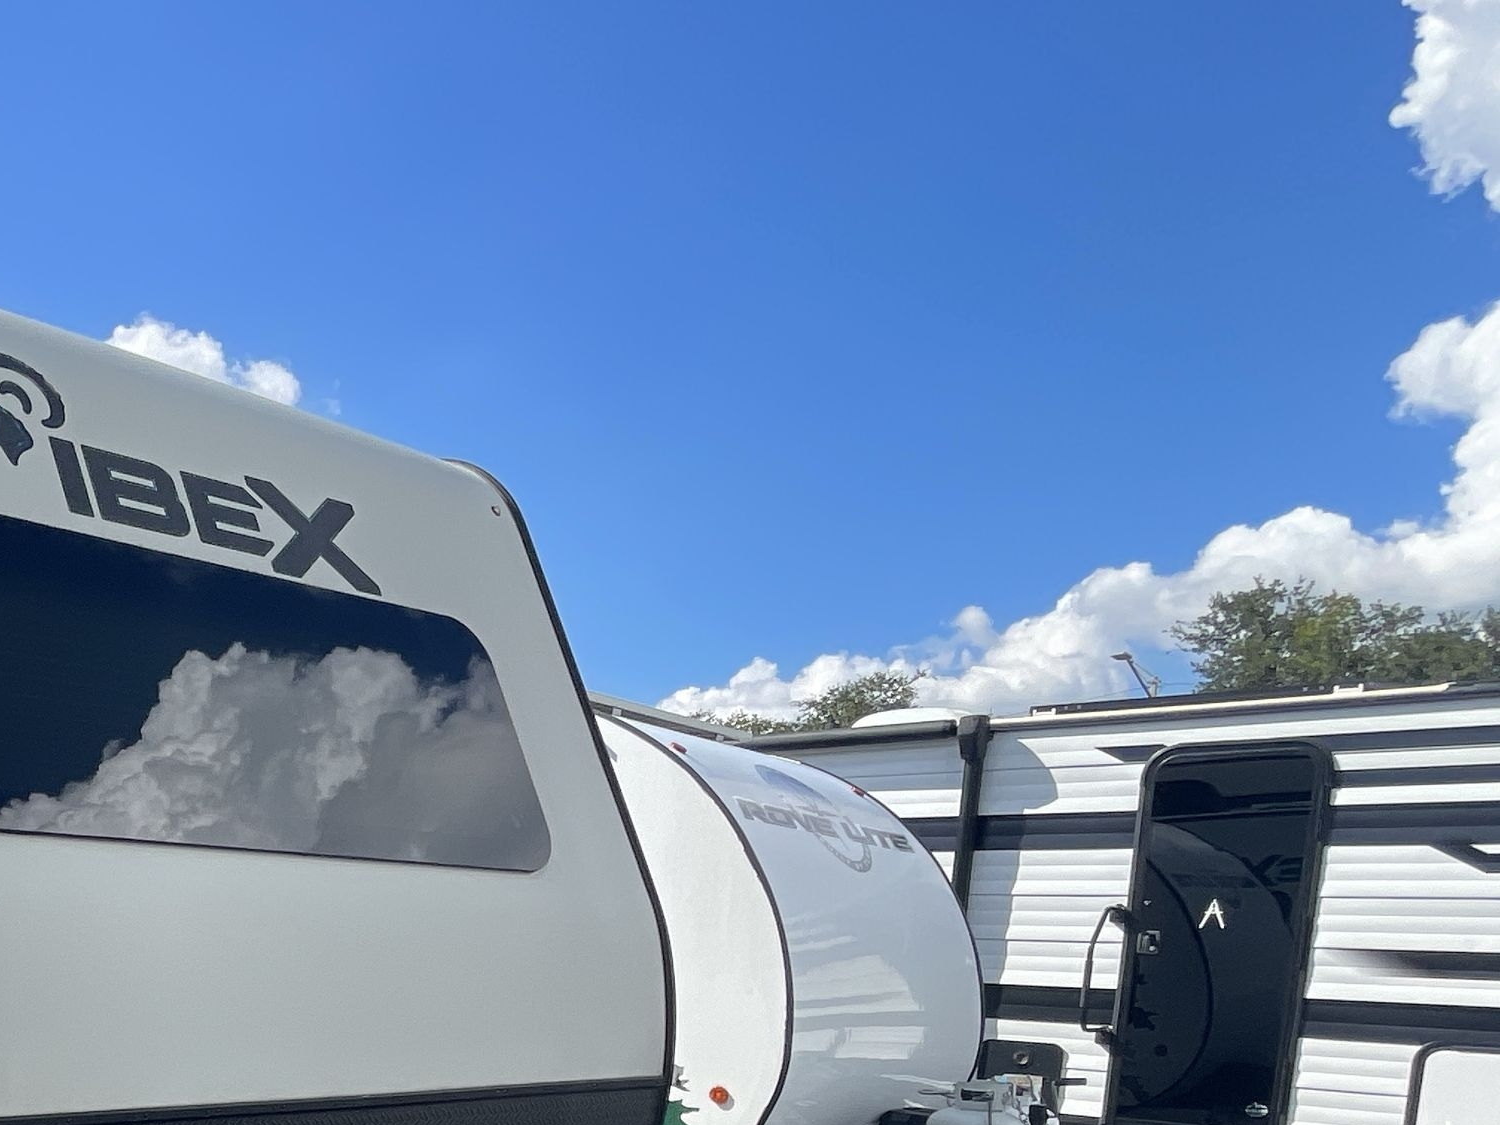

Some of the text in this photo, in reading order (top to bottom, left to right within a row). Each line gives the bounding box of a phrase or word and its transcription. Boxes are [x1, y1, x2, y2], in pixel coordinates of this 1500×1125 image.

[48, 435, 382, 596] IBEX
[735, 797, 915, 853] ROVE LITE
